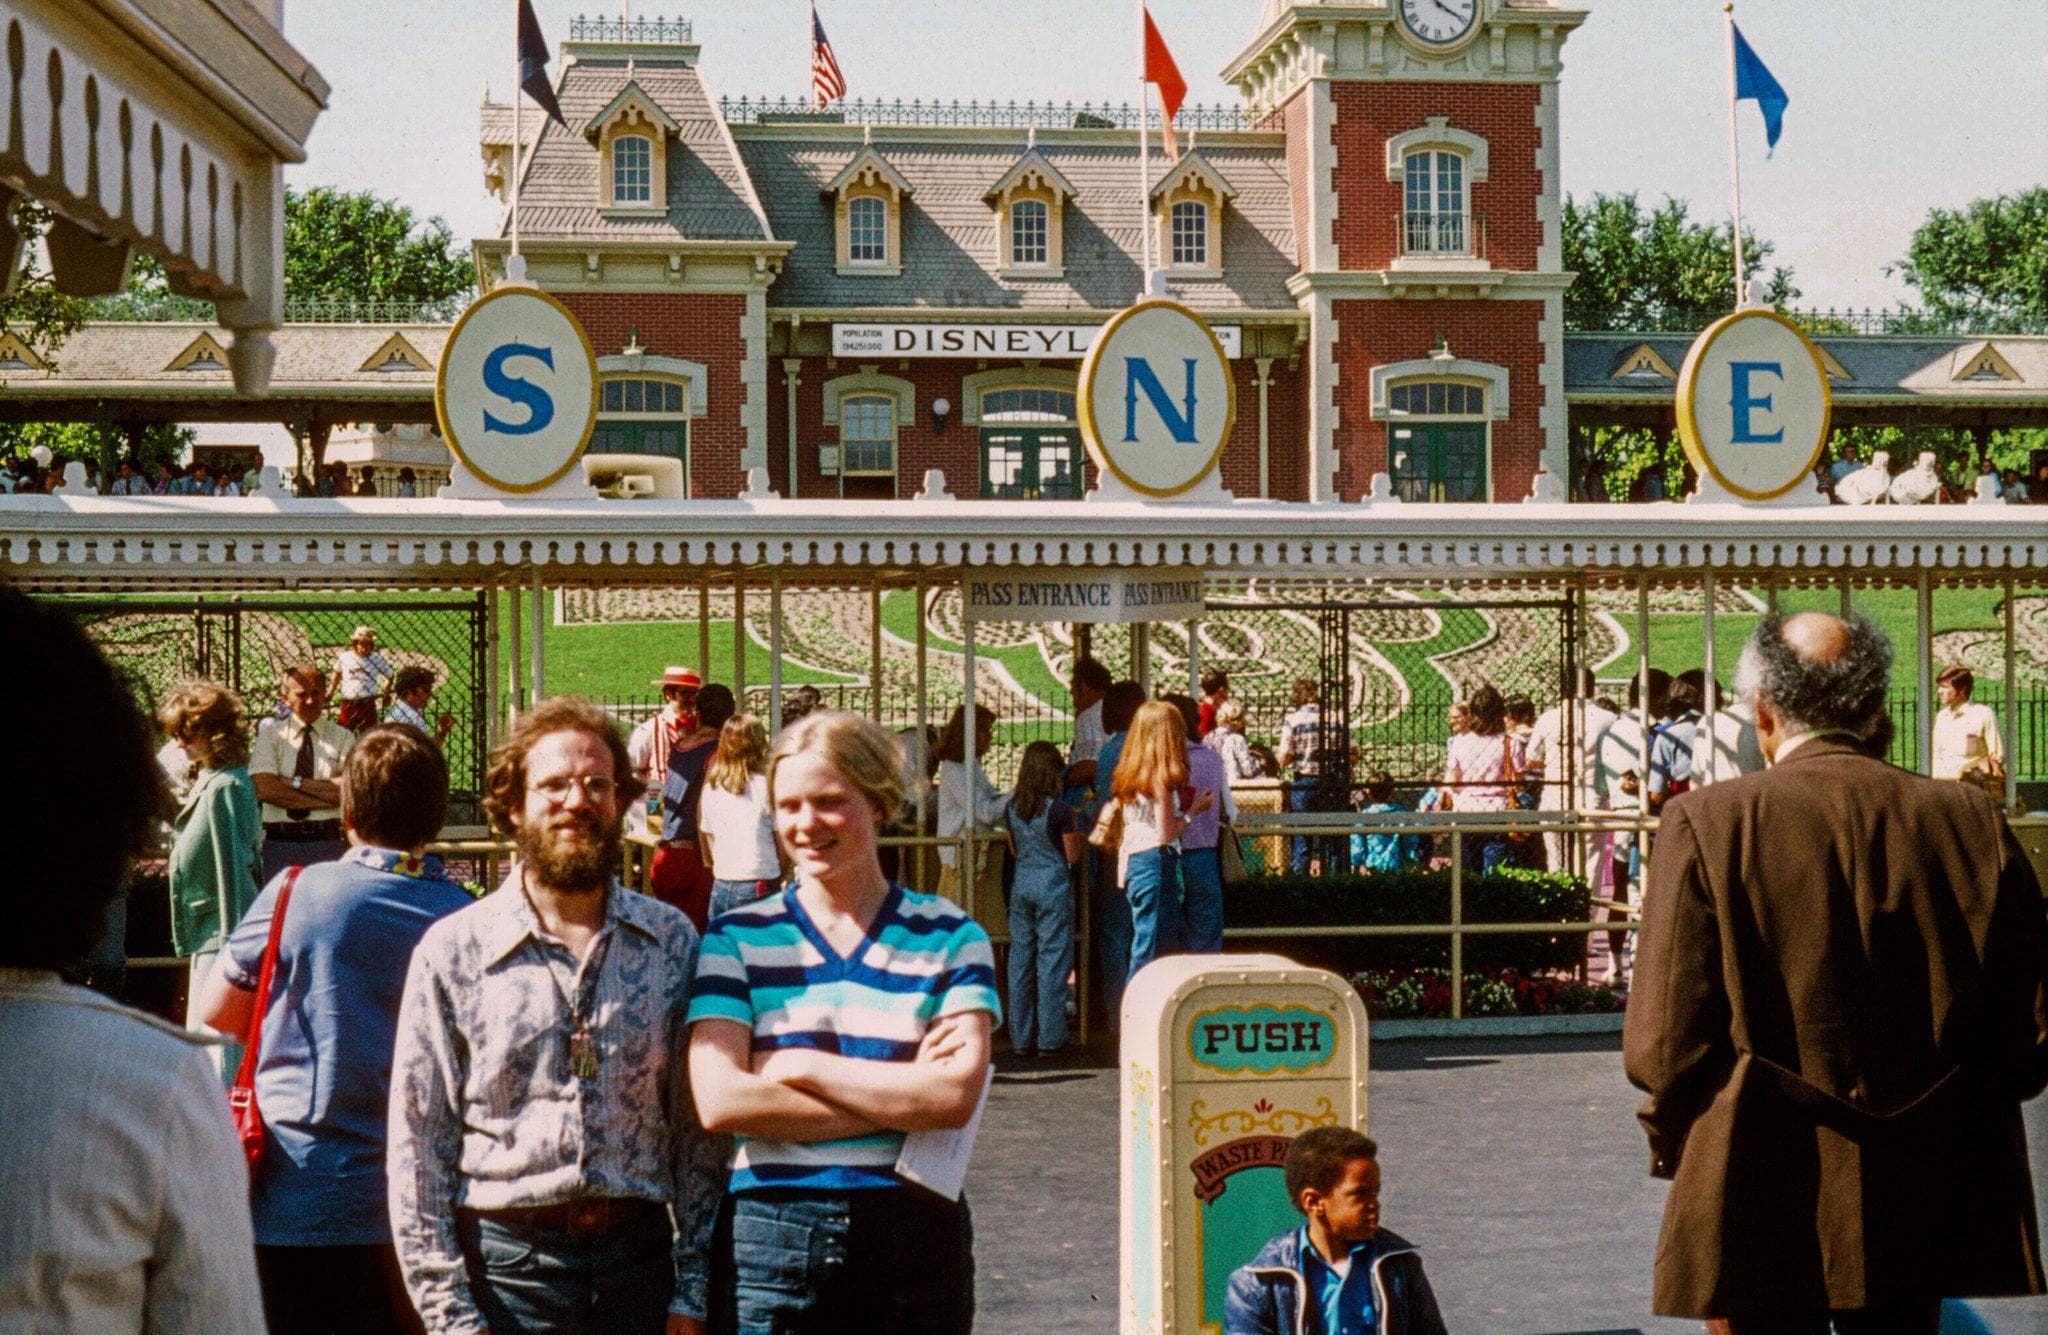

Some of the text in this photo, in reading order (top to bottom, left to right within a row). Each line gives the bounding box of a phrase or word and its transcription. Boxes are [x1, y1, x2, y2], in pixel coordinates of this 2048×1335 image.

[894, 329, 1088, 352] DISNEYL
[482, 343, 556, 436] S
[1121, 357, 1200, 444] N
[1728, 361, 1785, 444] E
[971, 581, 1111, 607] PASS ENTRANCE
[1123, 580, 1200, 606] PASS ENTRANCE
[1203, 1022, 1321, 1054] PUSH
[1198, 1141, 1261, 1178] WASTE
